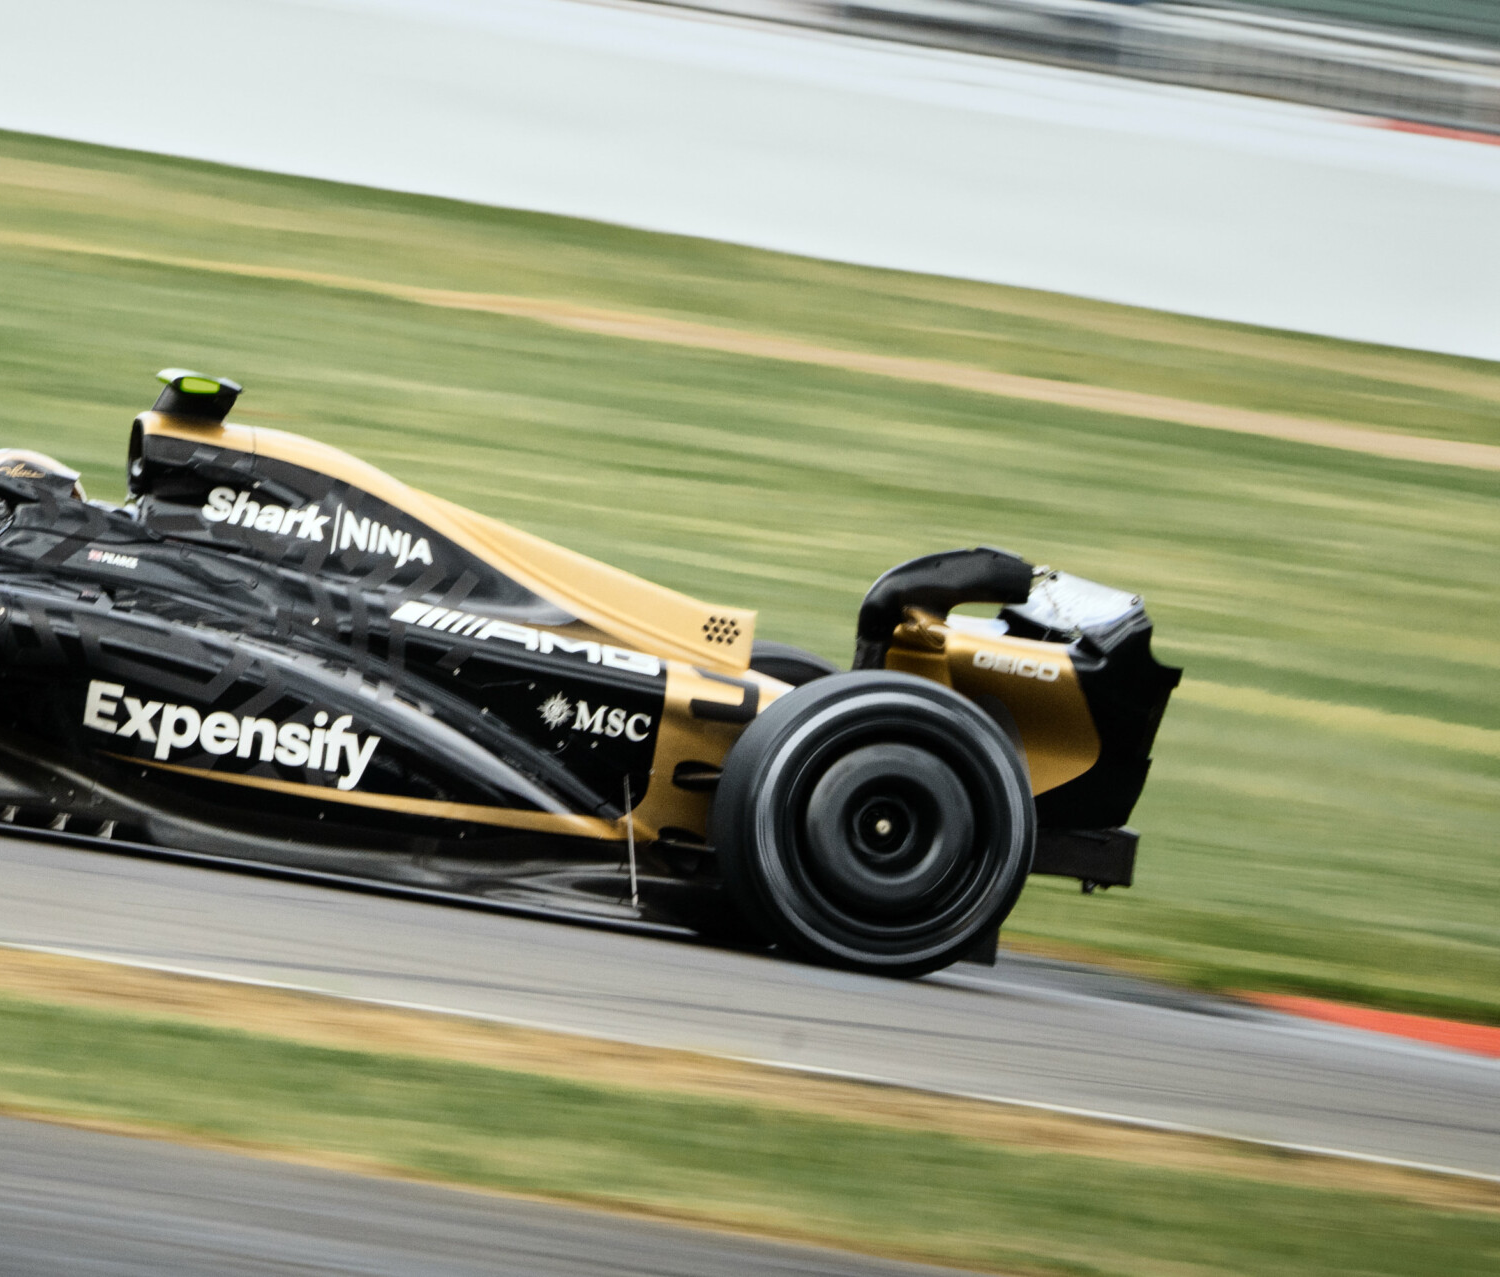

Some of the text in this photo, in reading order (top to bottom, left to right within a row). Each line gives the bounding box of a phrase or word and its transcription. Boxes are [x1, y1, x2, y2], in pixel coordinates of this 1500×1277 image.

[201, 486, 433, 569] Shark NINJA
[973, 650, 1060, 682] GEICO
[83, 679, 381, 790] Expensify
[572, 700, 651, 742] MSC
